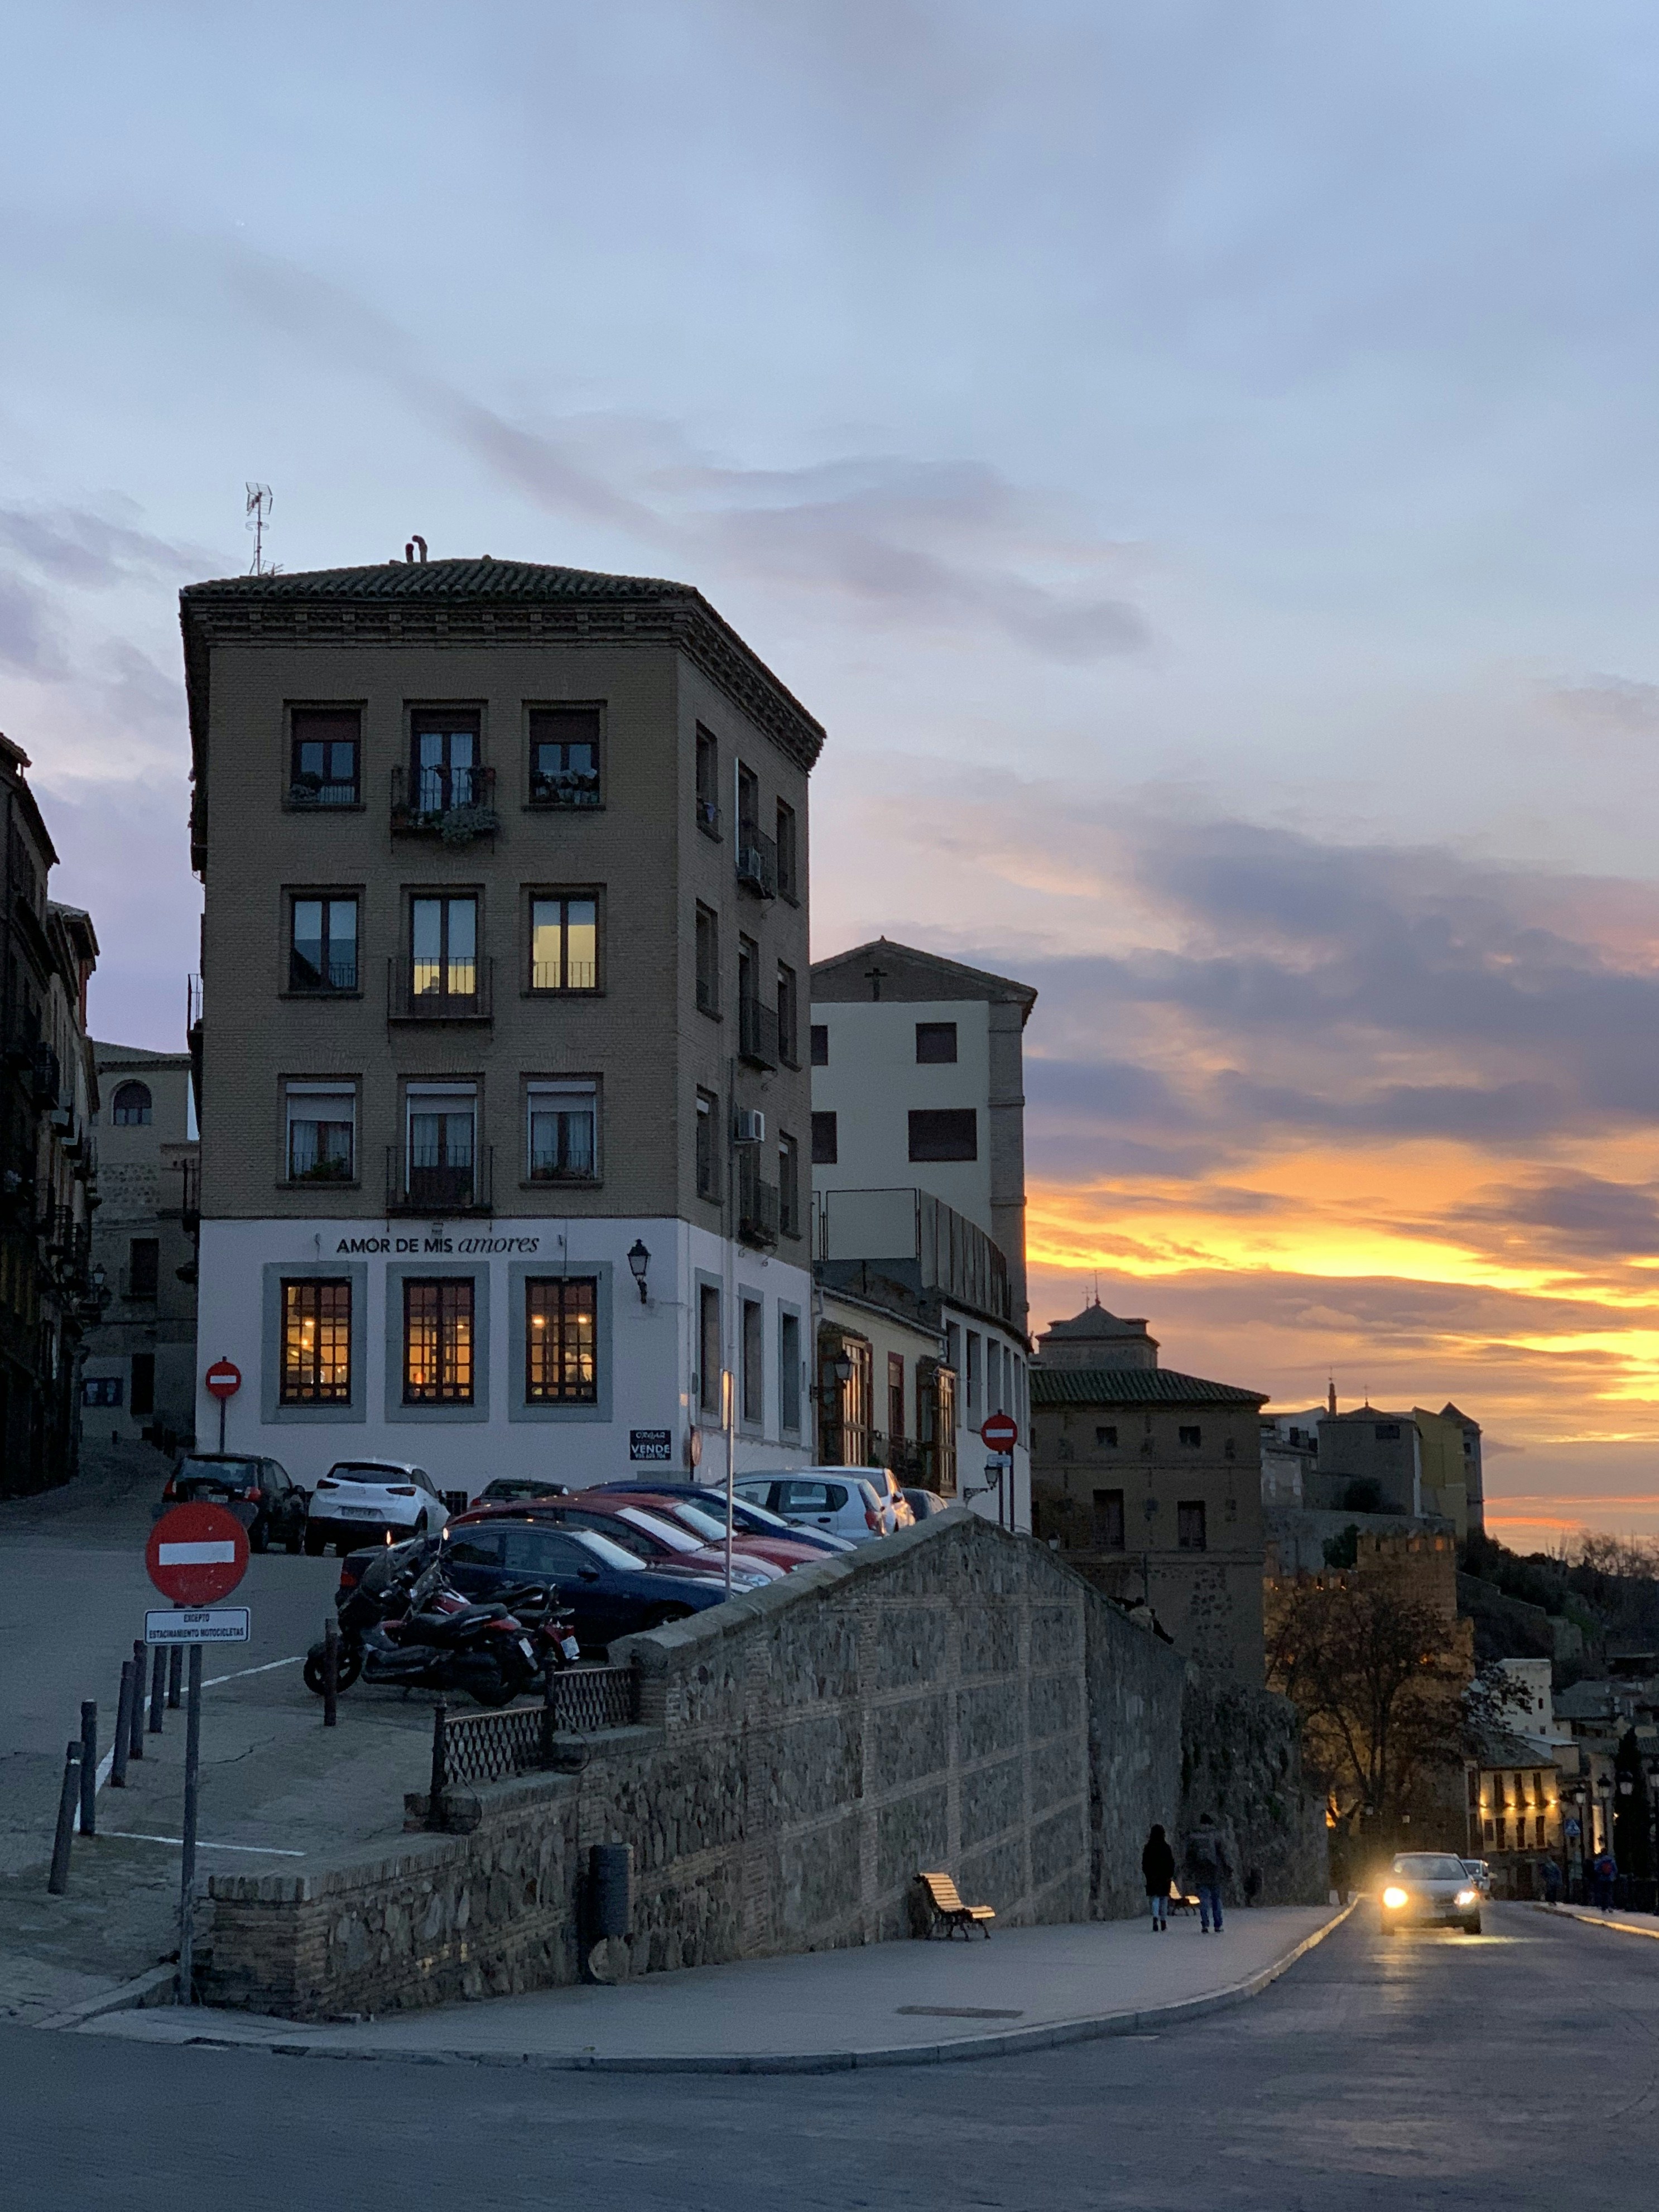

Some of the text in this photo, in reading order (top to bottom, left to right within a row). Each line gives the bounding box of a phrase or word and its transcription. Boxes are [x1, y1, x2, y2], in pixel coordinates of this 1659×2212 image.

[336, 1237, 540, 1254] AMOR DE MIS amores
[631, 1445, 670, 1453] VENDE
[184, 1614, 210, 1622] EXCEPTO
[201, 1628, 243, 1637] MOTOCICLETAS
